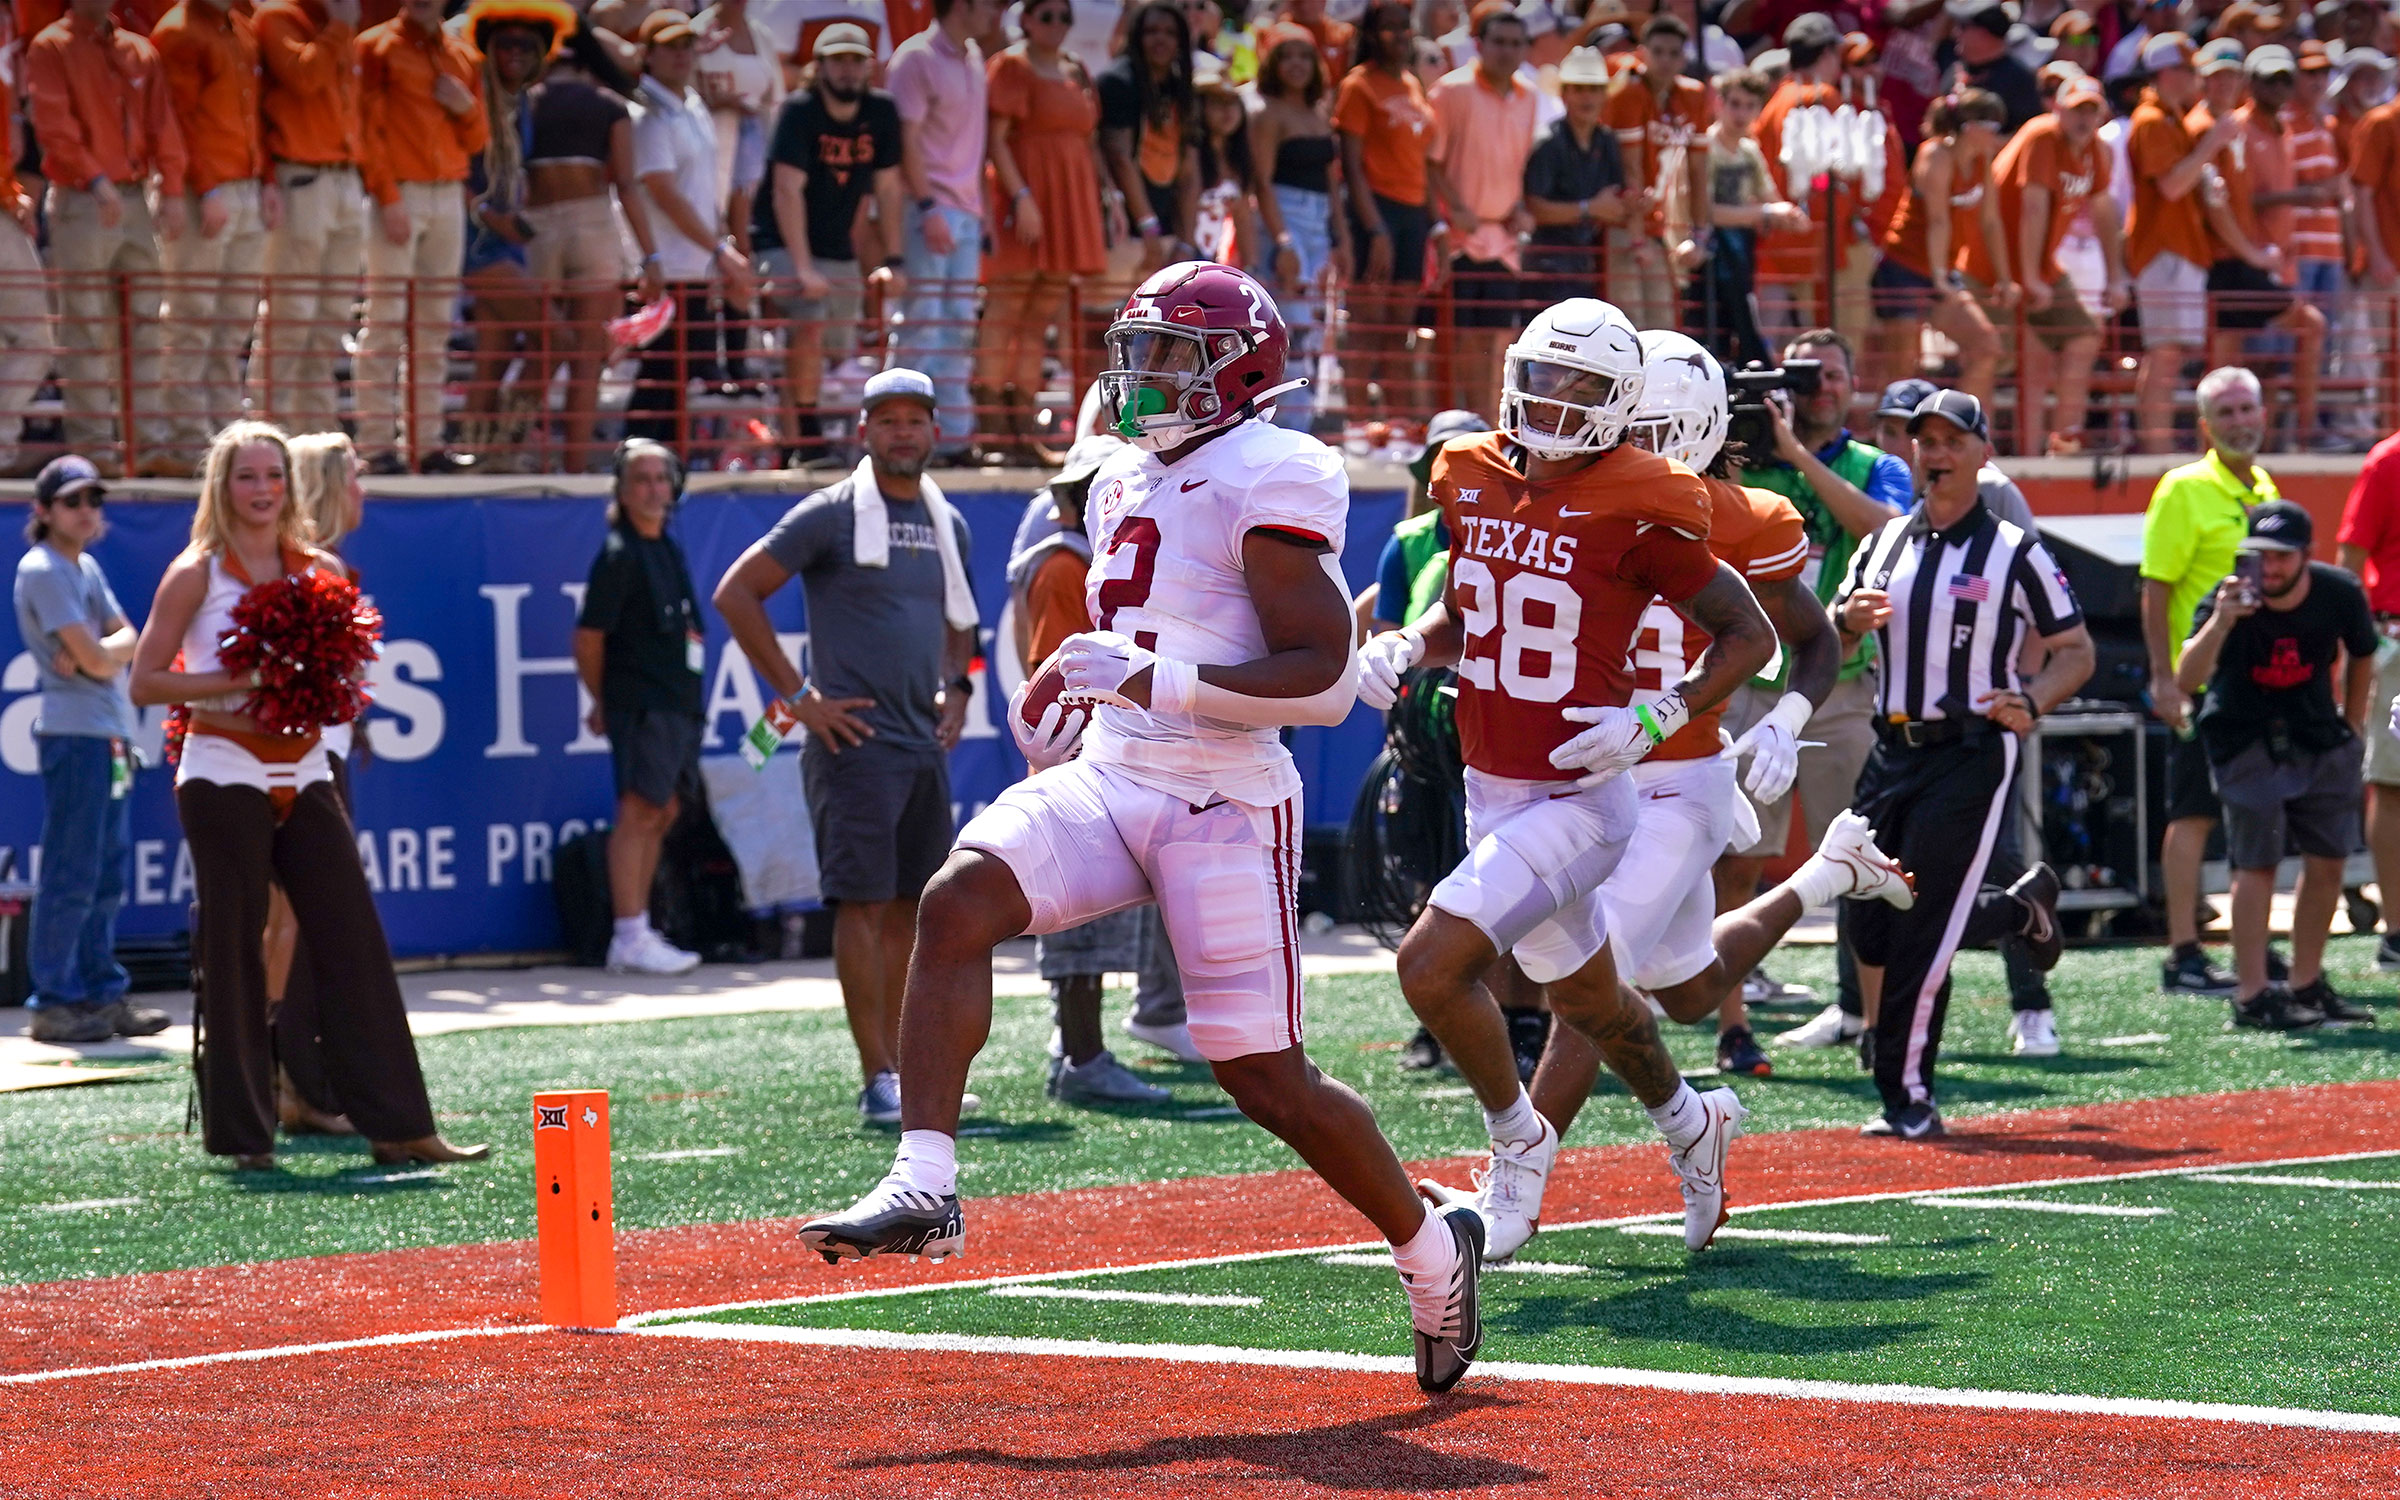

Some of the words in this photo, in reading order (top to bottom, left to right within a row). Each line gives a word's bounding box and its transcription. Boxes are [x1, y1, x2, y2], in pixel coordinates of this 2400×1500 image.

[1239, 283, 1267, 329] 2
[1549, 341, 1578, 353] HORNS
[1460, 516, 1578, 575] TEXAS
[1453, 557, 1583, 703] 28
[1953, 624, 1973, 649] F
[540, 1106, 568, 1129] XII
